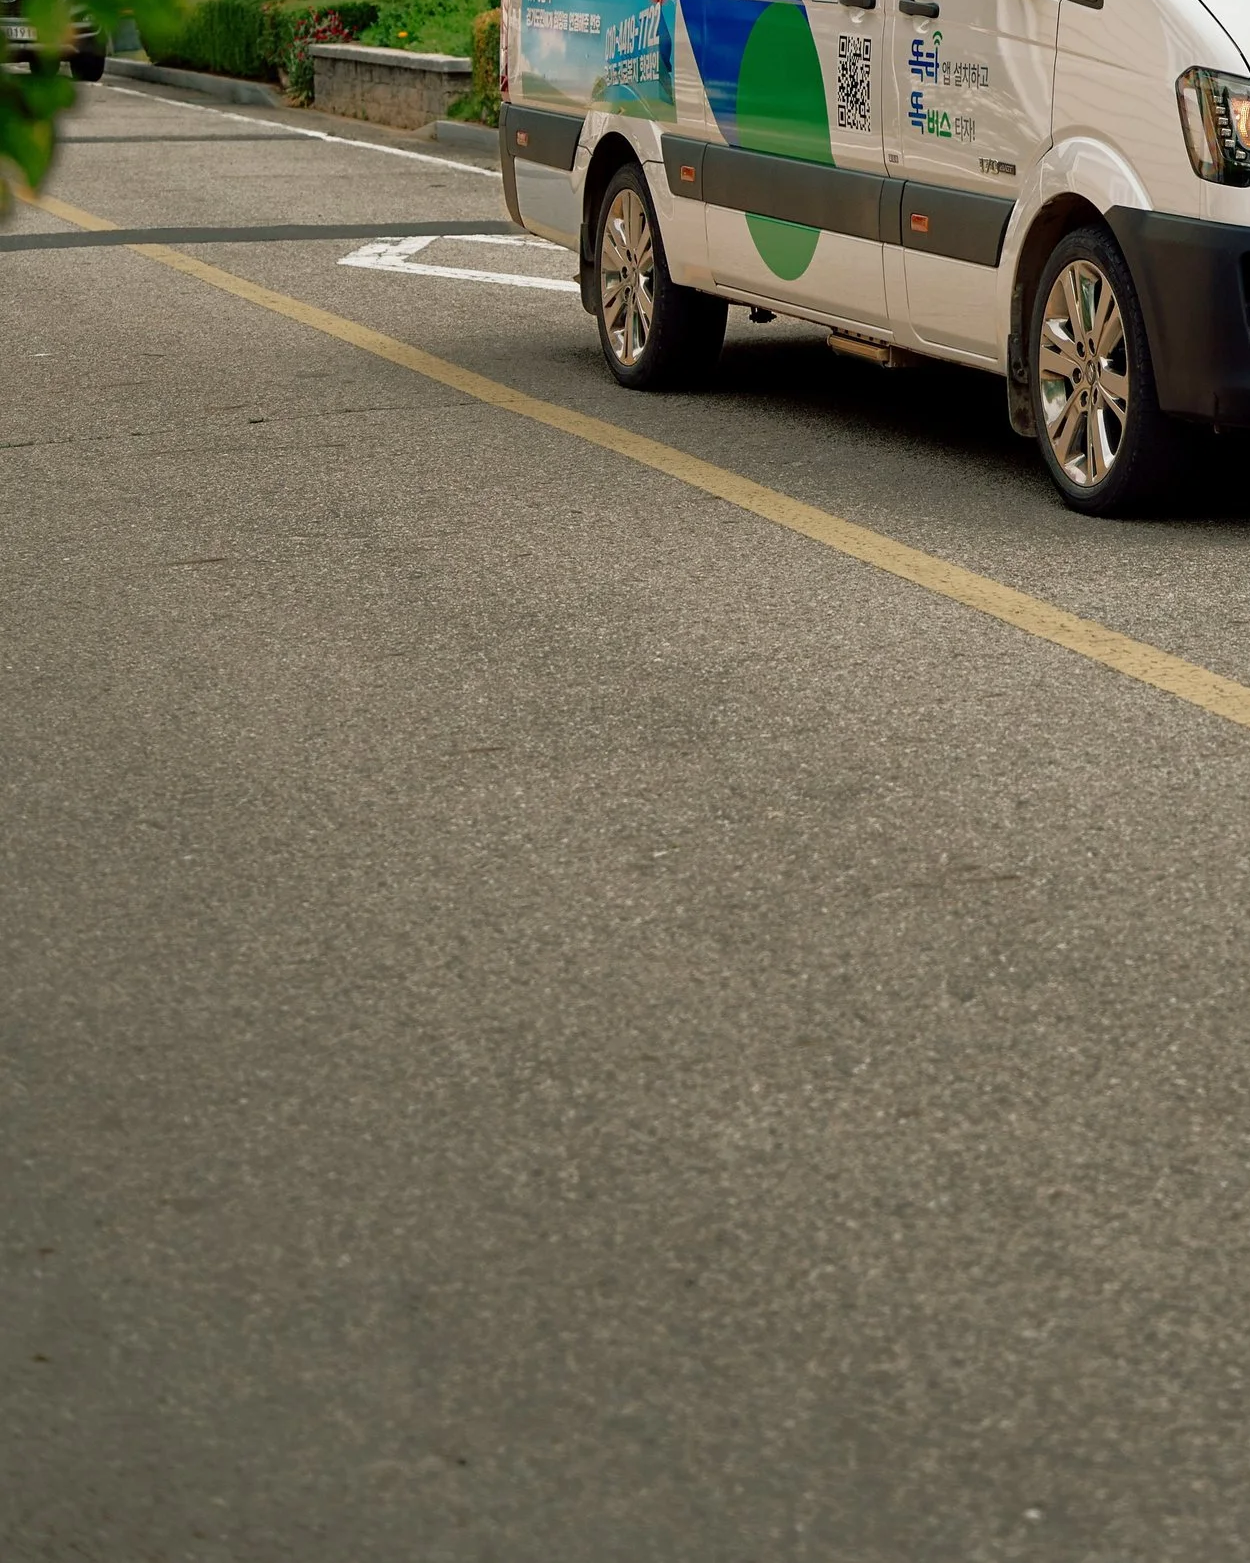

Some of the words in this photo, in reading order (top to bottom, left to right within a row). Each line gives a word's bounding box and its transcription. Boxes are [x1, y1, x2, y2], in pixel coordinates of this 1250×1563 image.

[604, 1, 662, 61] 010-4419-7722
[639, 51, 660, 82] 핫라인
[941, 61, 951, 86] 앱
[953, 62, 989, 89] 설치하고
[908, 91, 952, 138] 똑버스
[954, 116, 976, 143] 타자!
